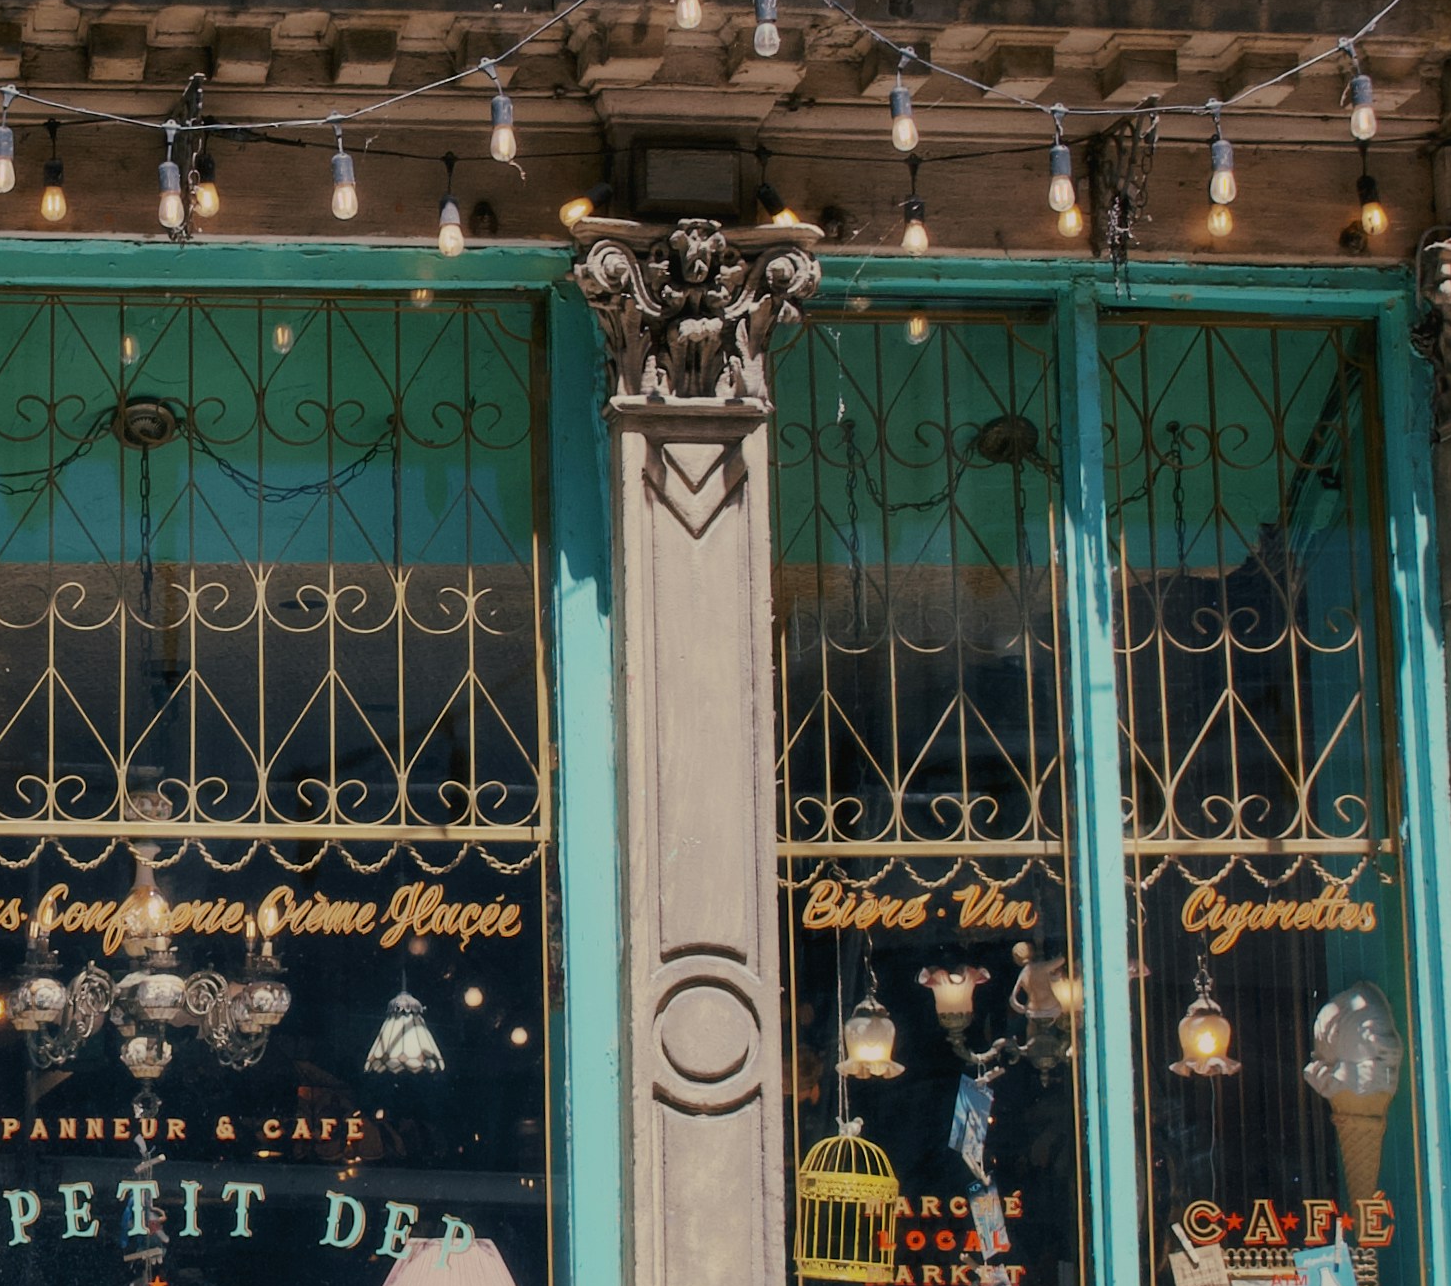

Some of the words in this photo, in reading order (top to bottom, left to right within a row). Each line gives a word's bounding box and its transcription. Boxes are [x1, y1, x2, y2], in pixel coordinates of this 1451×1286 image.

[257, 884, 376, 937] Crème
[379, 880, 523, 951] Glaçée
[802, 879, 927, 931] Bière
[952, 882, 1038, 931] Vin
[1181, 884, 1377, 954] Cigarettes
[215, 1117, 237, 1141] &
[264, 1111, 366, 1141] CAFÉ
[4, 1180, 266, 1248] PETIT
[318, 1190, 477, 1270] DEP
[1183, 1191, 1395, 1247] CAFÉ
